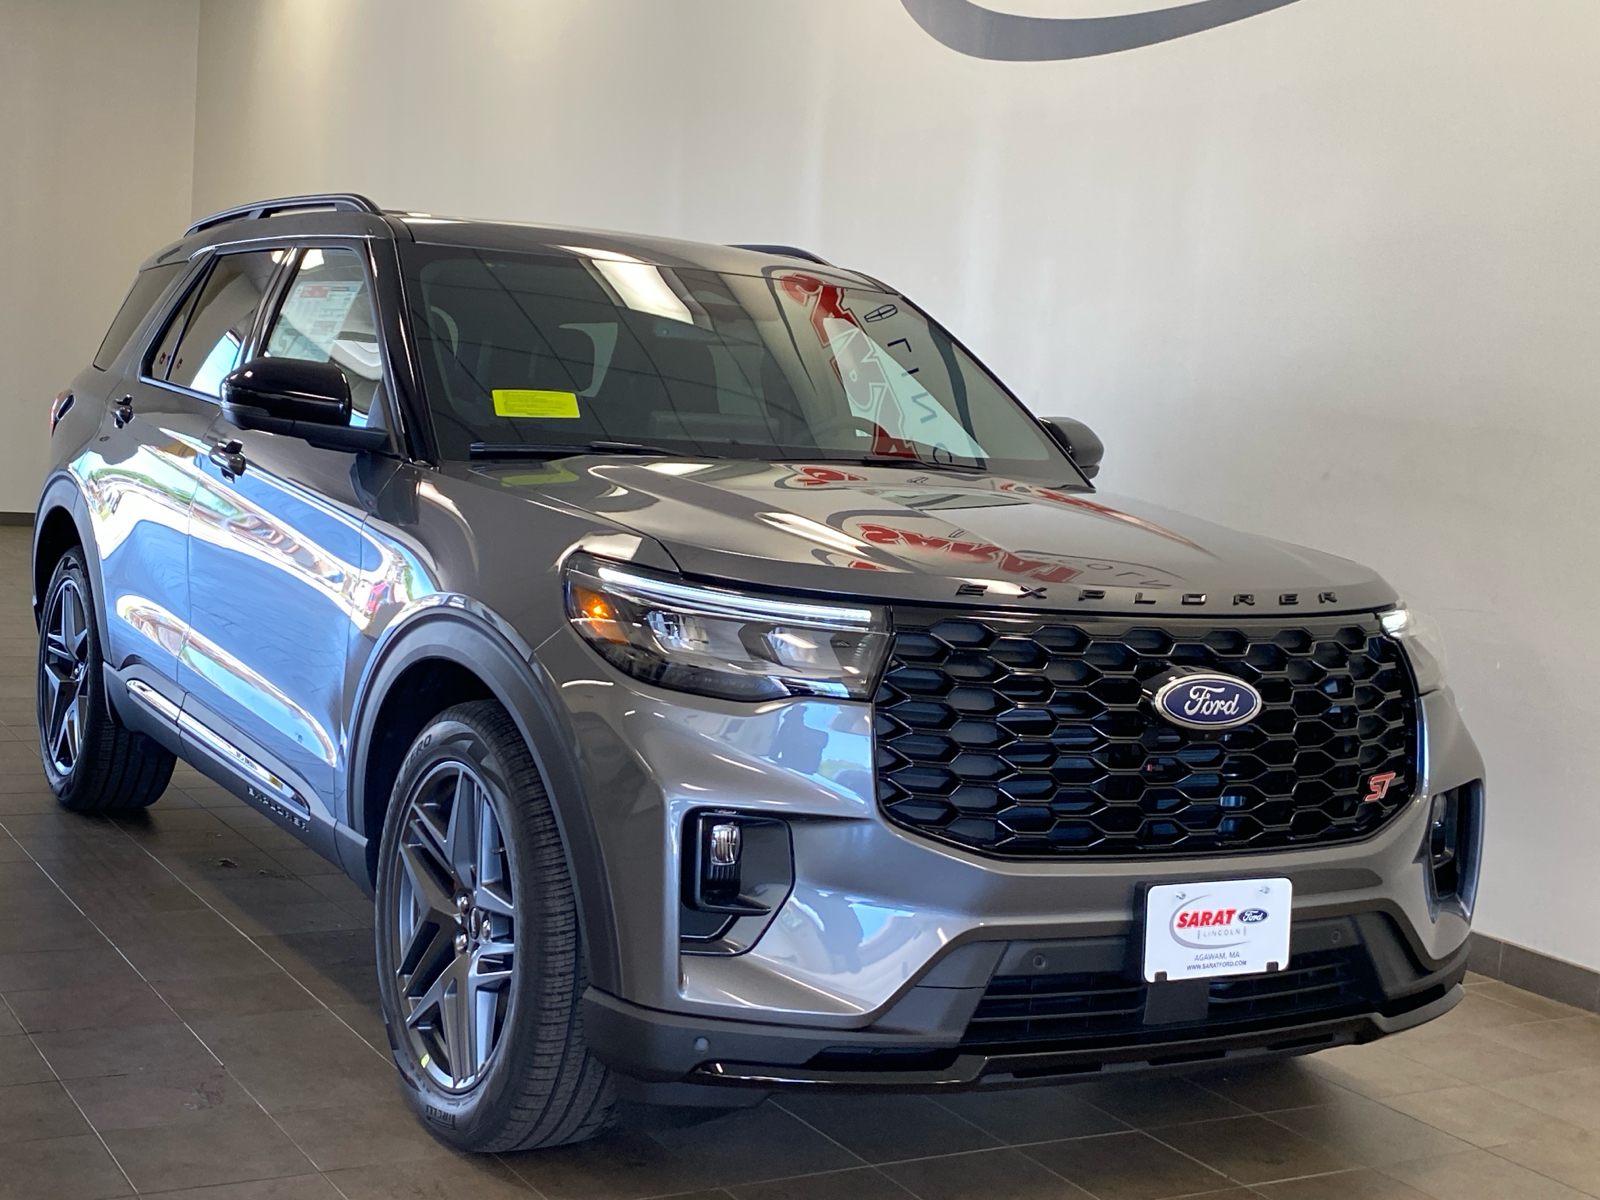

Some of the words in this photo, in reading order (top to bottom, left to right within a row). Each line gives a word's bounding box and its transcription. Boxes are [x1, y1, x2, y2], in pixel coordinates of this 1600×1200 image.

[955, 583, 1338, 607] EXPLORER
[1184, 685, 1240, 716] Ford
[1364, 771, 1396, 802] ST
[1175, 908, 1237, 929] SARAT
[1186, 960, 1247, 971] WWW.SARATFORD.COM
[1194, 952, 1227, 961] AGAWAM,
[1229, 951, 1240, 959] MA
[426, 1104, 457, 1130] PIRELLI
